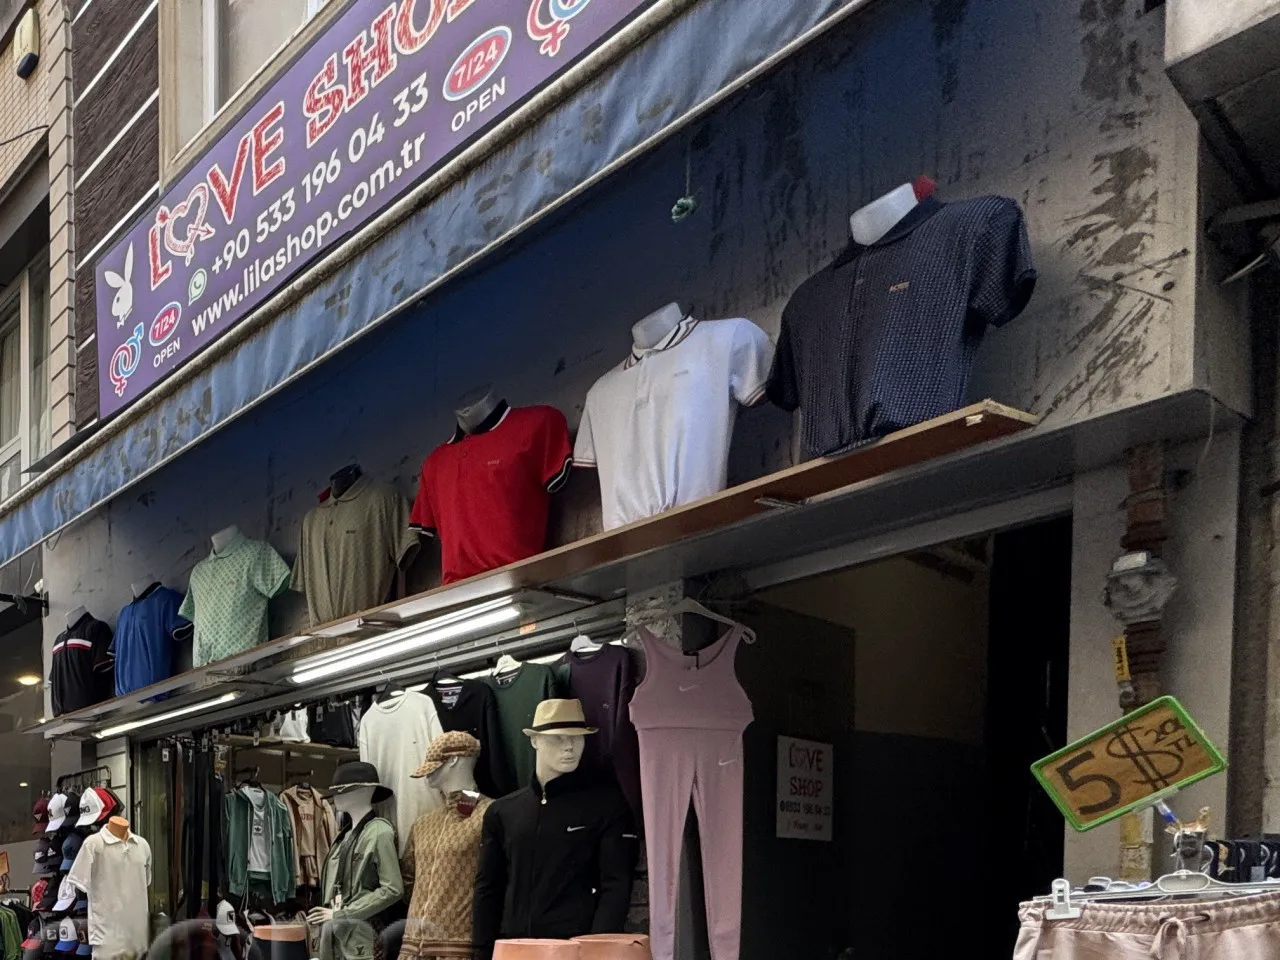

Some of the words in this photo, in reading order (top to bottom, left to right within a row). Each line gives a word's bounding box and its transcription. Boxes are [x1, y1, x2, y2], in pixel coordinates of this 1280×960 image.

[455, 39, 499, 88] 7/24
[452, 76, 505, 132] OPEN
[149, 101, 286, 291] LOVE
[303, 0, 479, 148] SHO
[212, 228, 249, 275] +90
[256, 187, 295, 243] 533
[301, 148, 341, 203] 196
[348, 112, 385, 163] 04
[393, 72, 428, 128] 33
[191, 132, 426, 336] www.lilashop.com.tr
[155, 309, 176, 339] 7/24
[153, 337, 180, 368] OPEN
[789, 776, 823, 798] SHOP
